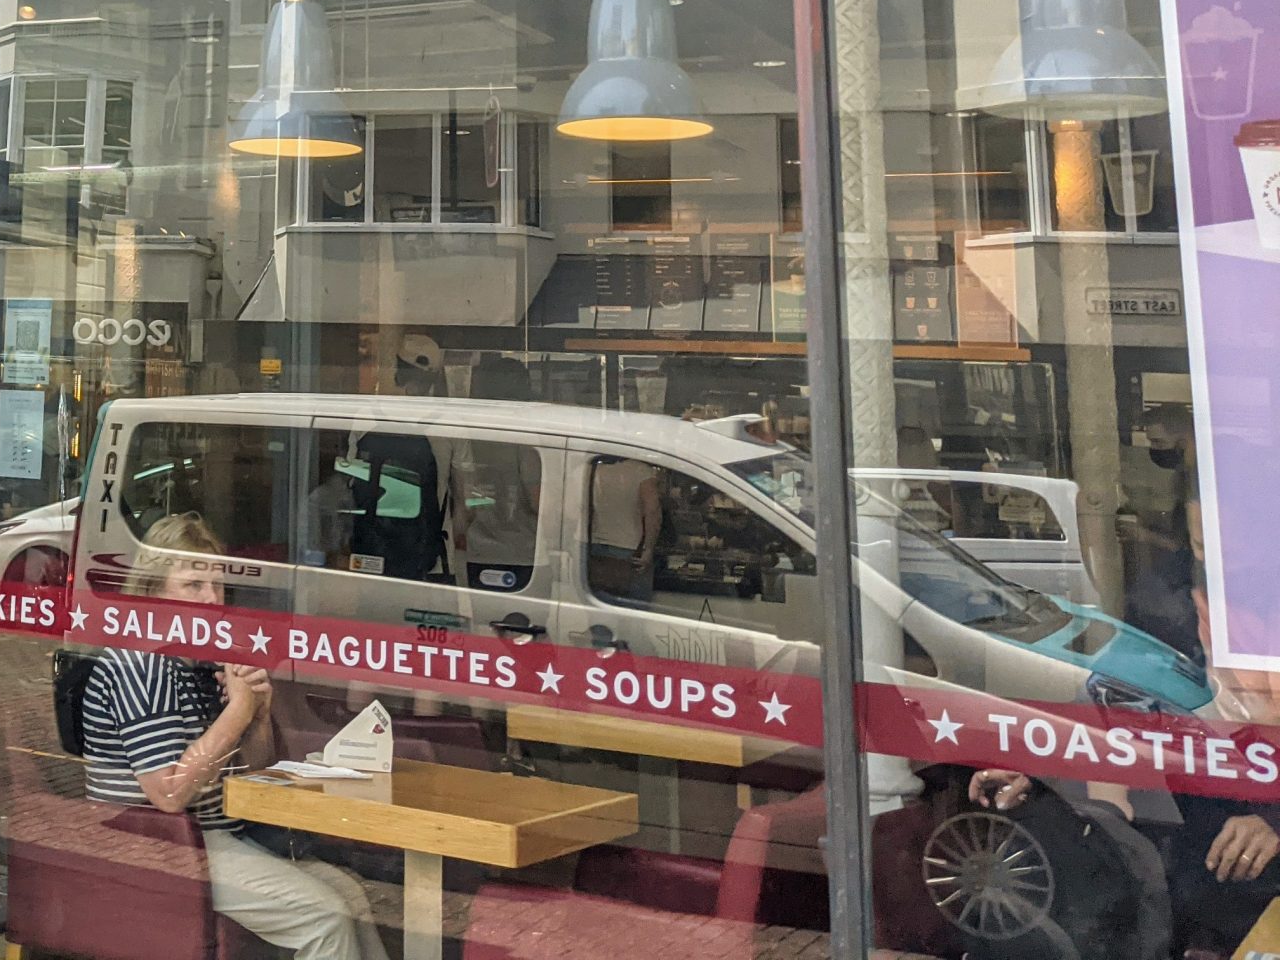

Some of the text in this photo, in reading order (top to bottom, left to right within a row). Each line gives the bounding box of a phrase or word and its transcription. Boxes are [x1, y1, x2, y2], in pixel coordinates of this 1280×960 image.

[99, 423, 123, 533] TAXI
[103, 607, 233, 650] SALADS
[288, 629, 517, 688] BAGUETTES
[585, 667, 737, 719] SOUPS
[988, 713, 1279, 783] TOASTIES
